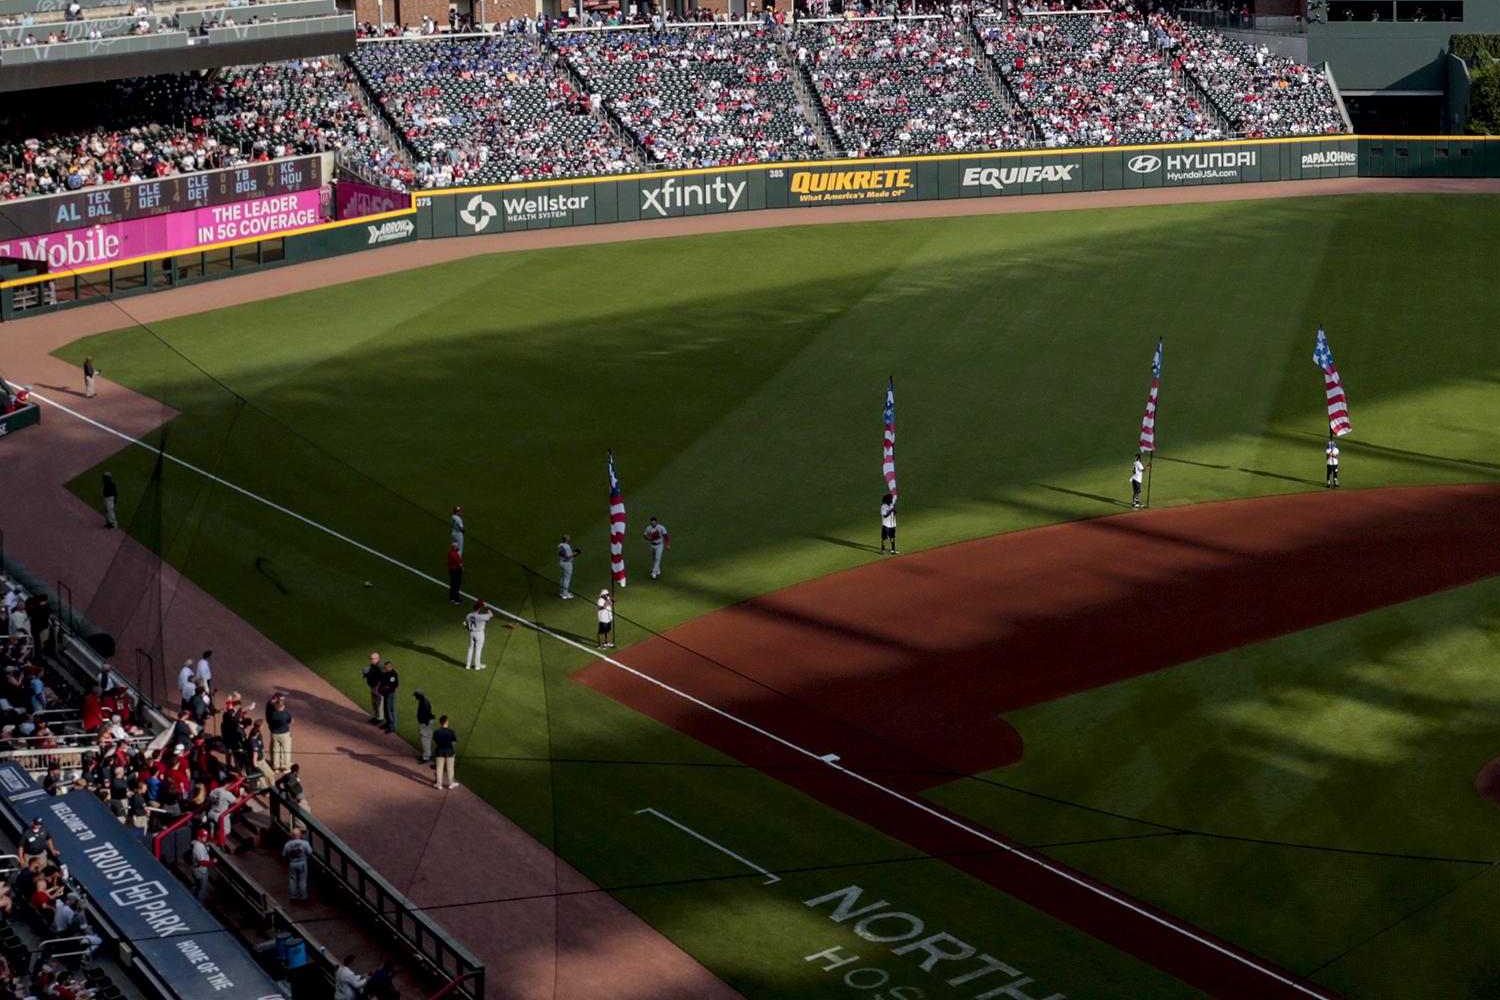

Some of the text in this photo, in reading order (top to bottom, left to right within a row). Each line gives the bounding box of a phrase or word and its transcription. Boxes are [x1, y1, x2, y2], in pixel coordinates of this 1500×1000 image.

[1167, 151, 1256, 170] HYUNDAI
[1302, 154, 1323, 164] PAPA
[281, 161, 294, 173] KC
[770, 169, 784, 178] 385
[235, 169, 249, 181] TB
[281, 172, 302, 185] HOU
[791, 169, 911, 193] QUIKRETE
[963, 164, 1074, 189] EQUIFAX
[1167, 169, 1237, 180] HyundaiUSA.com
[187, 175, 208, 189] CLE
[235, 180, 257, 193] BOS
[138, 182, 160, 197] CLE
[187, 187, 209, 200] DET
[642, 175, 747, 216] xfinity
[824, 191, 864, 200] America's
[867, 190, 890, 199] Made
[87, 191, 111, 205] TEX
[138, 194, 161, 209] DET
[416, 197, 431, 207] 375
[504, 195, 589, 213] Wellstar
[56, 202, 81, 224] AL
[88, 203, 112, 218] BAL
[212, 208, 241, 223] THE
[244, 195, 298, 219] LEADER
[508, 211, 567, 222] HEALTH SYSTEM
[198, 206, 315, 243] IN 5G COVERAGE
[84, 842, 190, 938] TRUIST PARK
[176, 939, 235, 991] HOME OF THE
